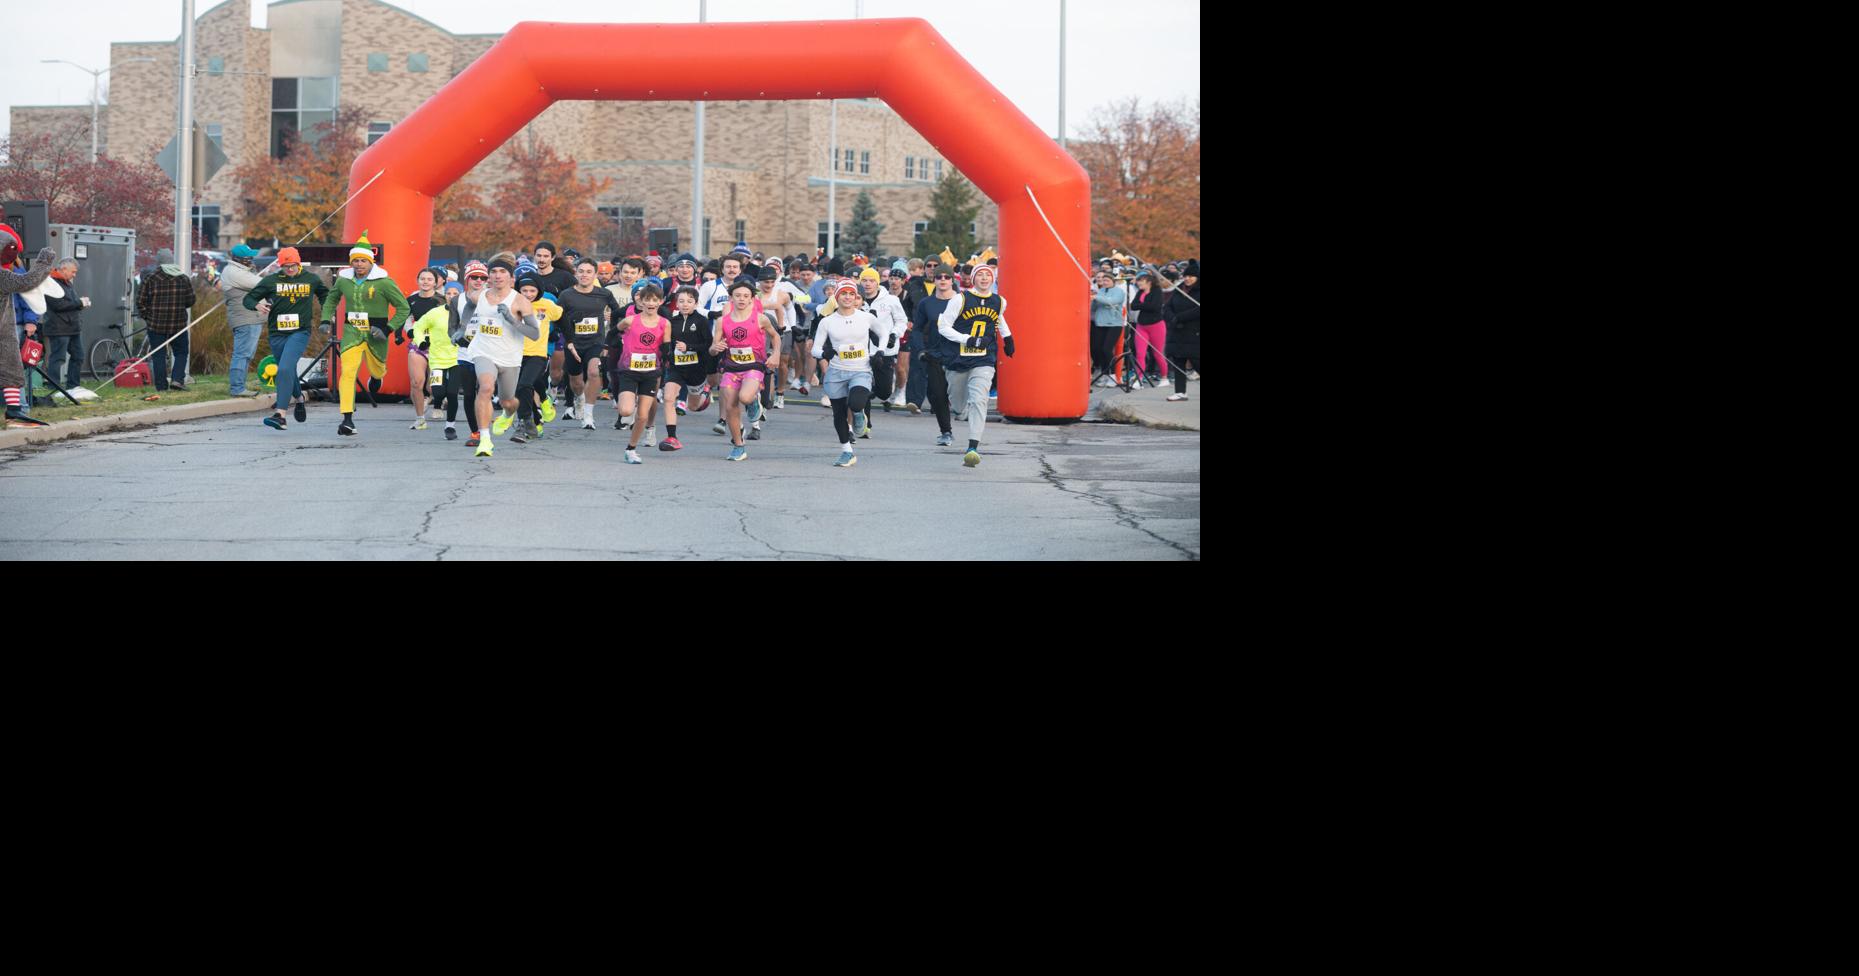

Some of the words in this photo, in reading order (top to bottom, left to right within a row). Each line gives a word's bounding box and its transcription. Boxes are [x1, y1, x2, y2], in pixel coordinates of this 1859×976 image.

[276, 283, 311, 294] BAYLOR
[677, 355, 695, 363] 5270
[843, 350, 862, 359] 5898
